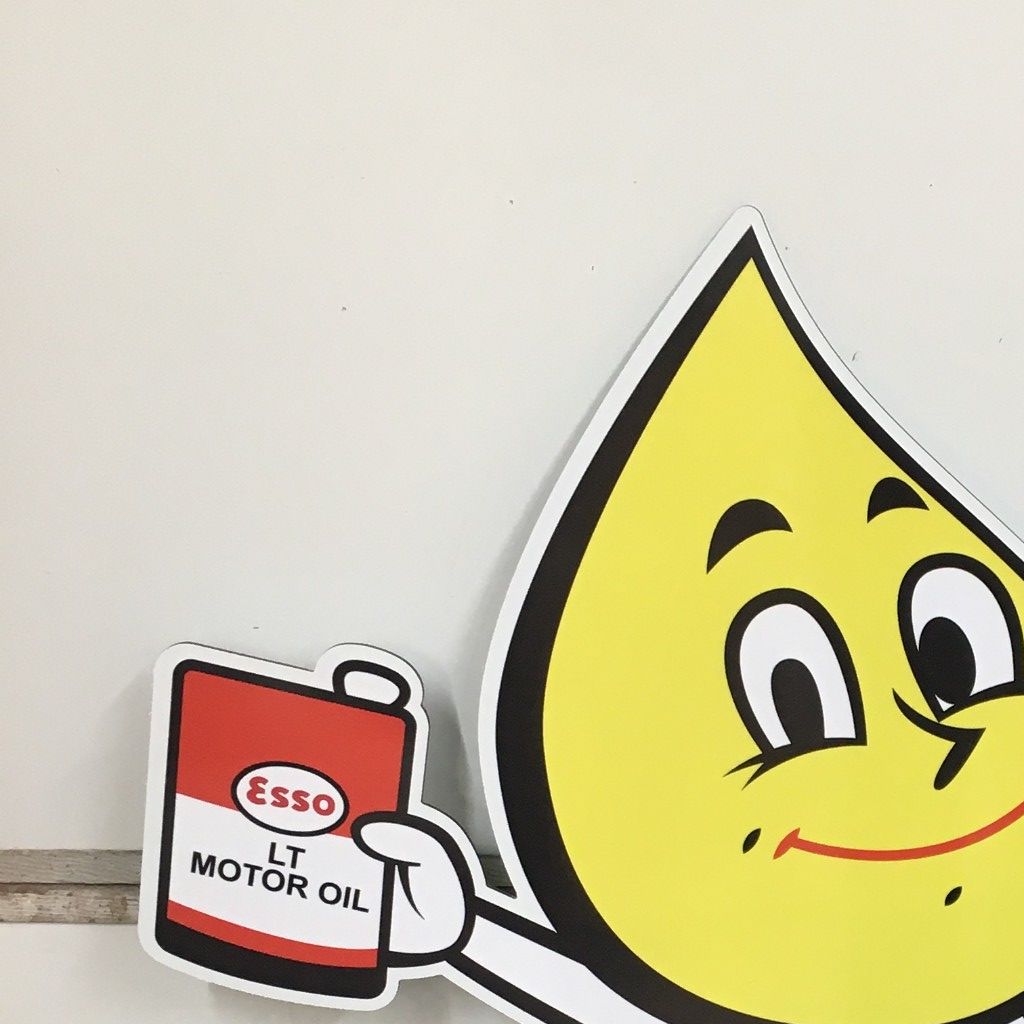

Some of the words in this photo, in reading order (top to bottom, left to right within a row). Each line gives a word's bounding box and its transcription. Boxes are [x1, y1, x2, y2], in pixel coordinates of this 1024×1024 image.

[268, 841, 306, 869] LT
[190, 851, 309, 899] MOTOR
[318, 882, 370, 913] OIL
